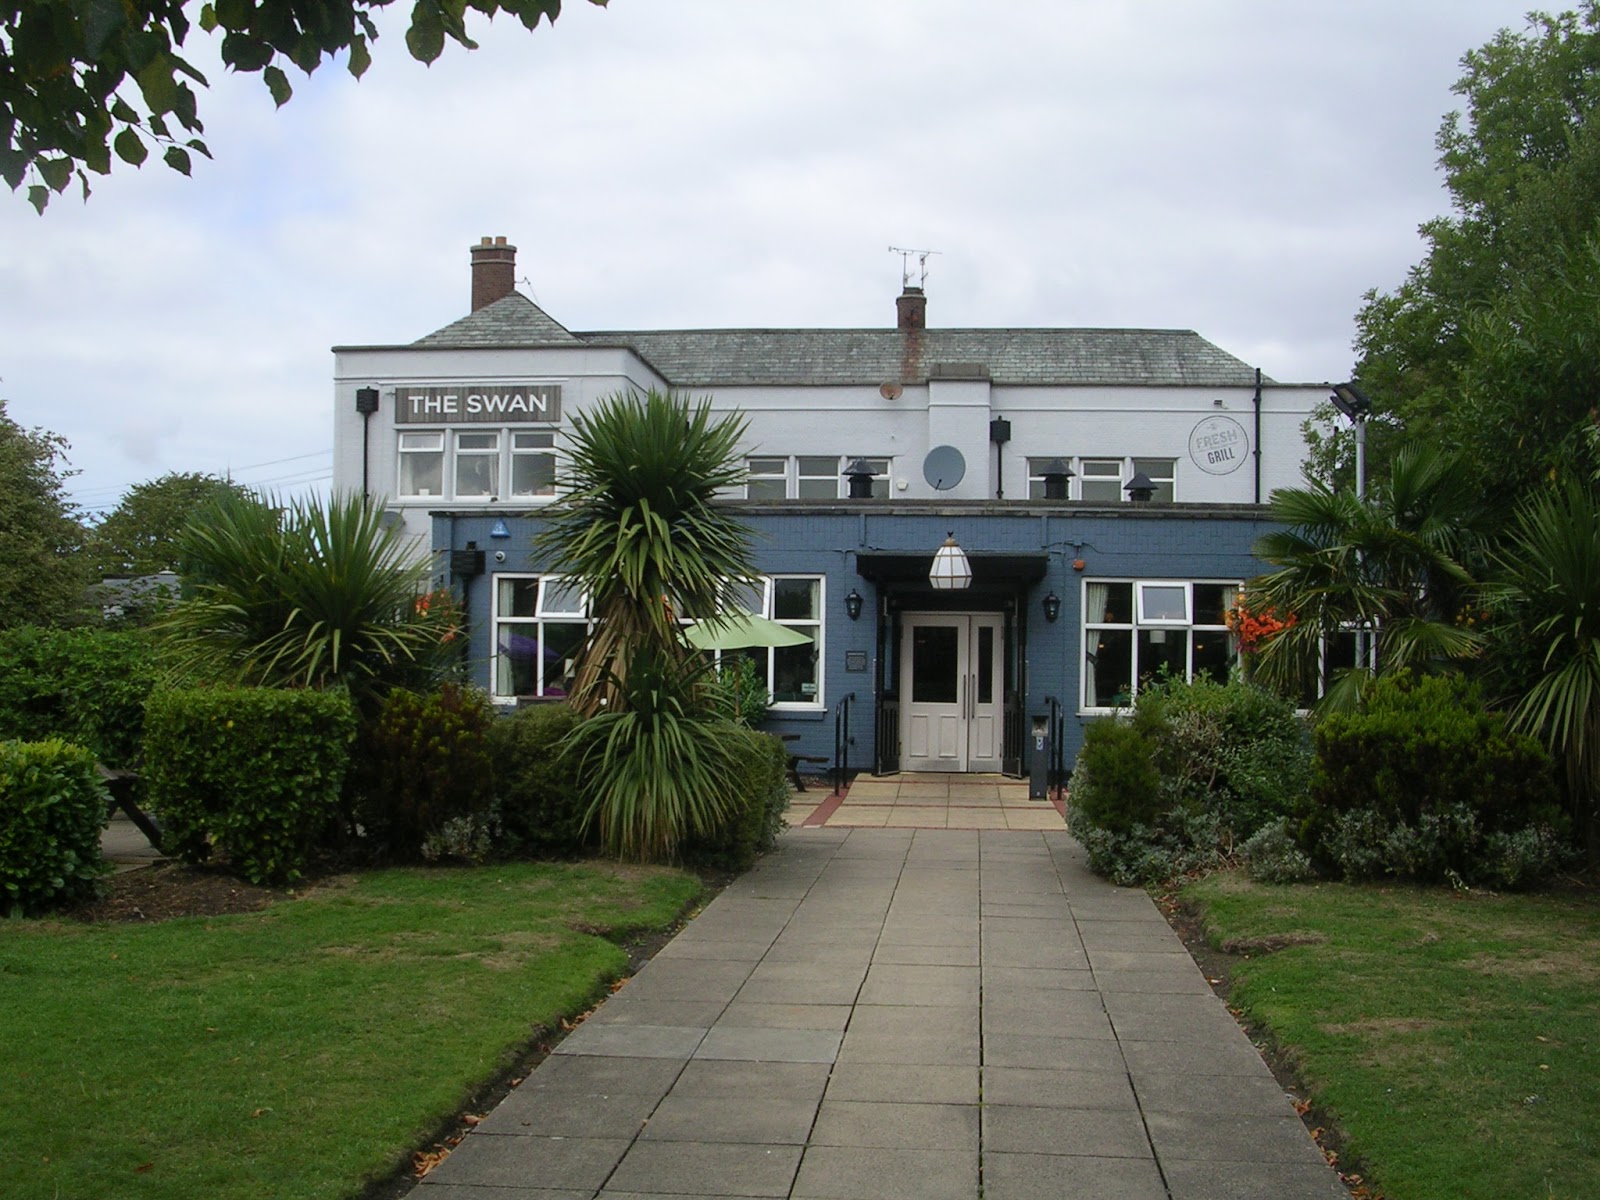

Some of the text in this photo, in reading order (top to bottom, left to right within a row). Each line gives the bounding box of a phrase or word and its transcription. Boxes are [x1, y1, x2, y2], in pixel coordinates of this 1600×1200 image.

[408, 394, 547, 414] THE SWAN
[1196, 429, 1237, 448] FRESH
[1207, 447, 1235, 464] GRILL
